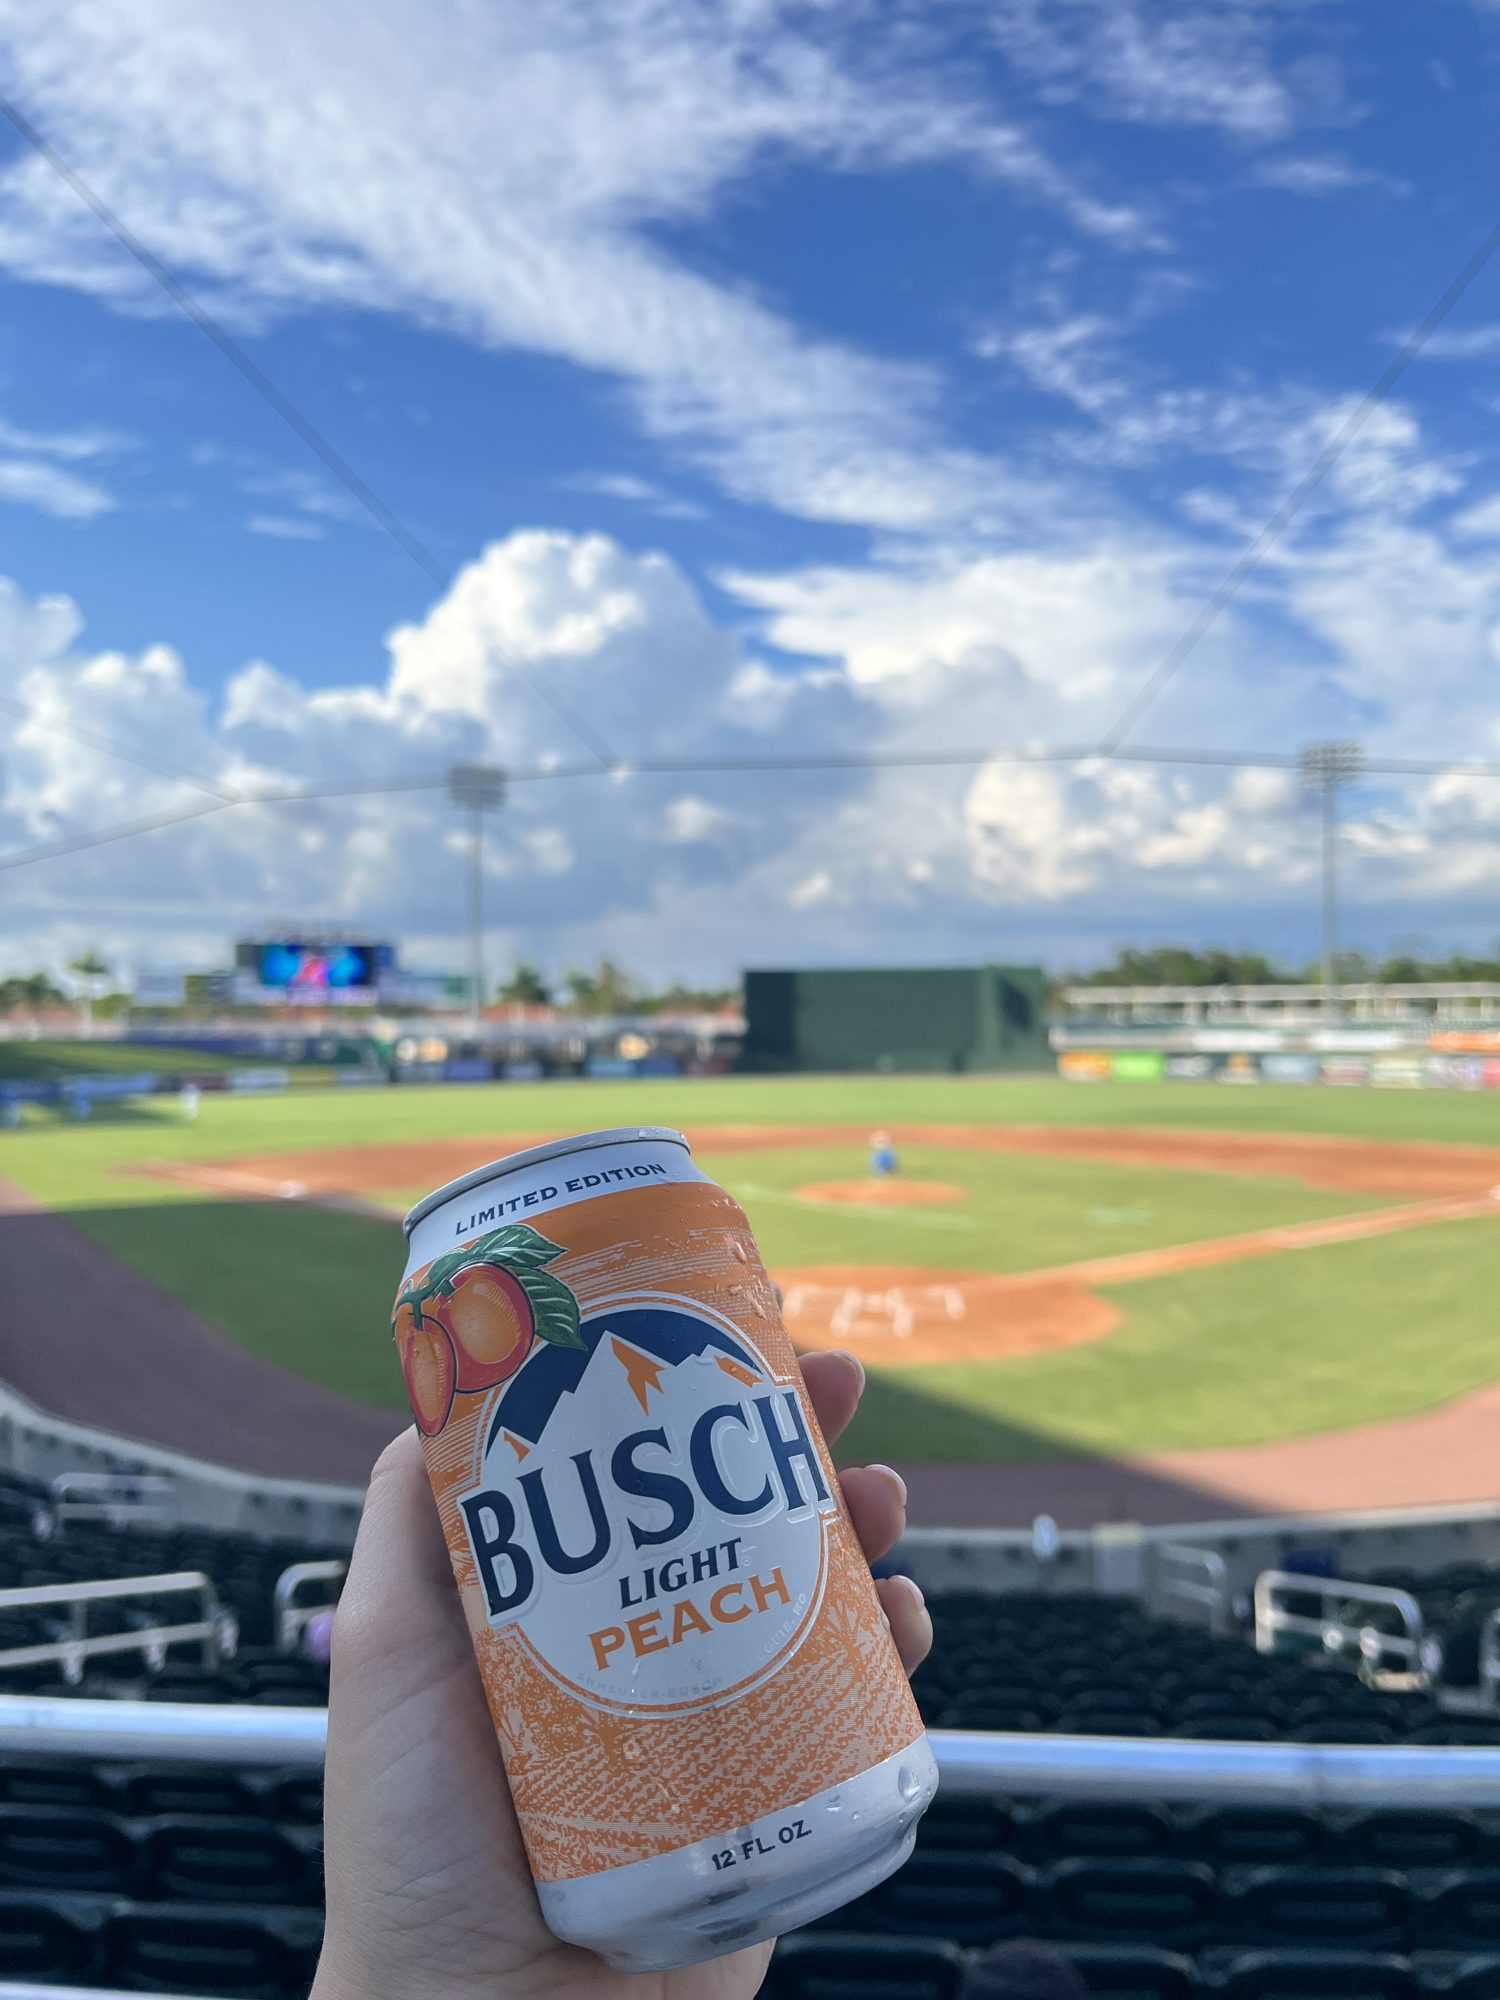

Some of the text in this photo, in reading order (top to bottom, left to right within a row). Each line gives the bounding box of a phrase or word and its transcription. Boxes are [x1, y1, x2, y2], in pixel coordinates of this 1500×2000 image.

[455, 1163, 667, 1235] LIMITED EDITION
[460, 1391, 831, 1616] BUSCH
[618, 1537, 743, 1609] LIGHT
[588, 1566, 792, 1671] PEACH
[711, 1819, 812, 1870] 12 FL. OZ.
